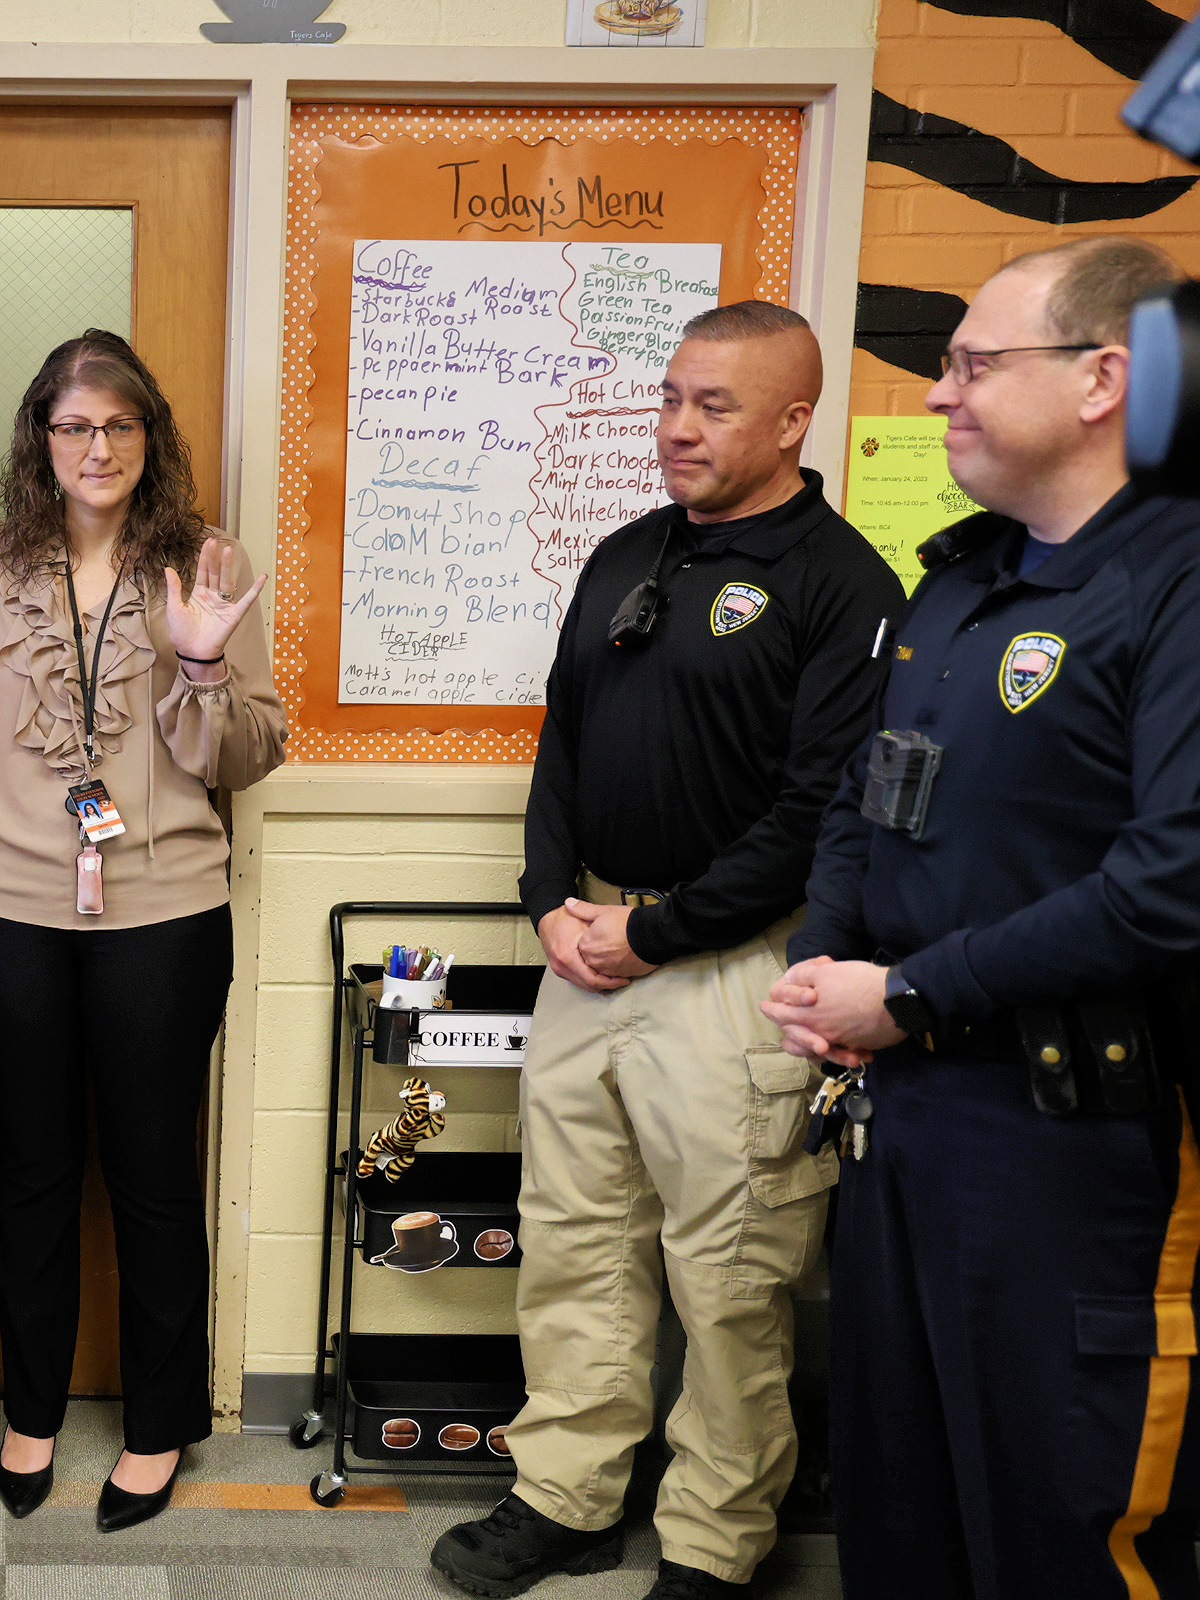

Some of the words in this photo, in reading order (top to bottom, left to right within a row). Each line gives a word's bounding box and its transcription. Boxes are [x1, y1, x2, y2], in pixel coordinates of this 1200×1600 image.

[438, 160, 566, 236] Today's
[578, 175, 664, 219] Menu
[357, 241, 433, 284] Coffee
[601, 247, 649, 269] Tea
[583, 272, 647, 294] English
[578, 291, 633, 308] Green
[641, 298, 673, 315] Tea
[443, 328, 519, 360] Butter
[495, 358, 569, 388] Bark
[578, 381, 606, 404] Hot
[479, 419, 532, 452] Bun
[886, 435, 903, 443] Tigers
[379, 441, 492, 480] Decaf
[953, 502, 968, 510] BAR
[445, 563, 520, 597] Roast
[725, 586, 765, 606] POLICE
[466, 589, 554, 630] Blend
[388, 640, 439, 657] CIDER
[419, 632, 468, 648] APPLE
[404, 668, 437, 685] hot
[443, 668, 499, 689] apple
[346, 680, 418, 697] Caramel
[428, 686, 476, 704] apple
[419, 1031, 500, 1047] COFFEE
